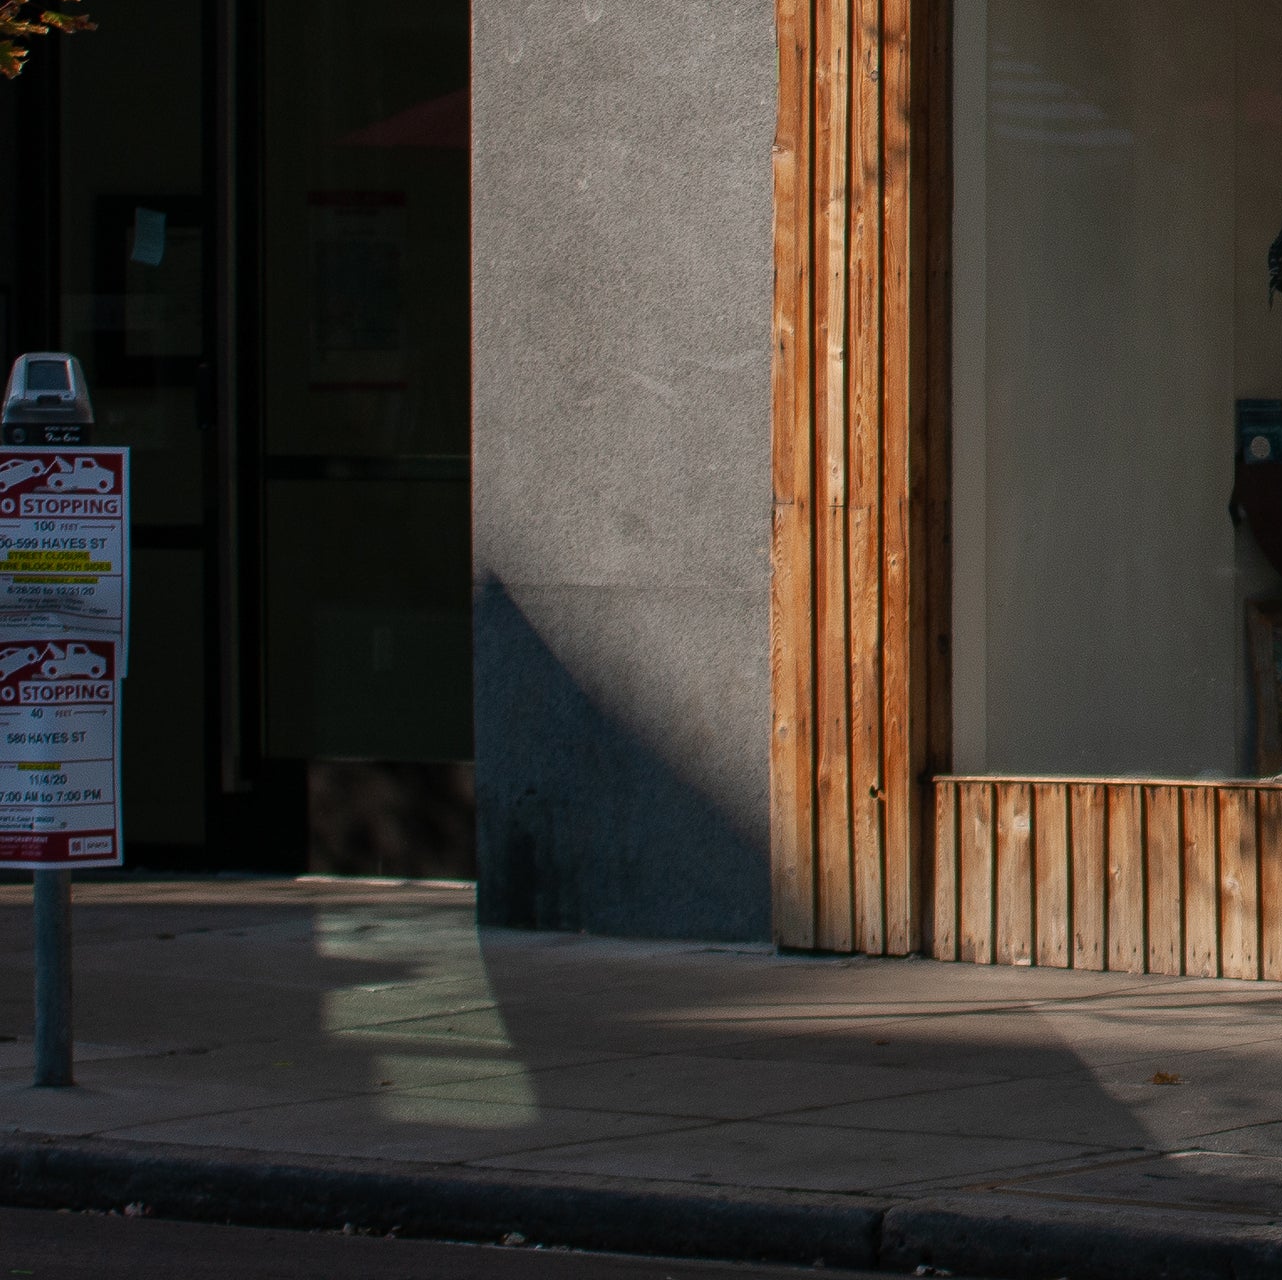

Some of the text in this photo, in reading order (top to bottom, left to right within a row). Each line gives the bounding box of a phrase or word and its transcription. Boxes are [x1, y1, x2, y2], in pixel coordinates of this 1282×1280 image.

[1, 496, 117, 514] O STOPPING
[34, 521, 55, 532] 100
[42, 537, 86, 549] HAYES
[90, 537, 108, 549] ST
[1, 684, 110, 702] O STOPPING
[31, 707, 43, 718] 40
[28, 731, 69, 743] HAYES
[72, 731, 87, 742] ST
[30, 774, 68, 785] 11/4/20
[41, 791, 53, 802] to
[57, 790, 82, 801] 7:00
[84, 788, 102, 800] PM
